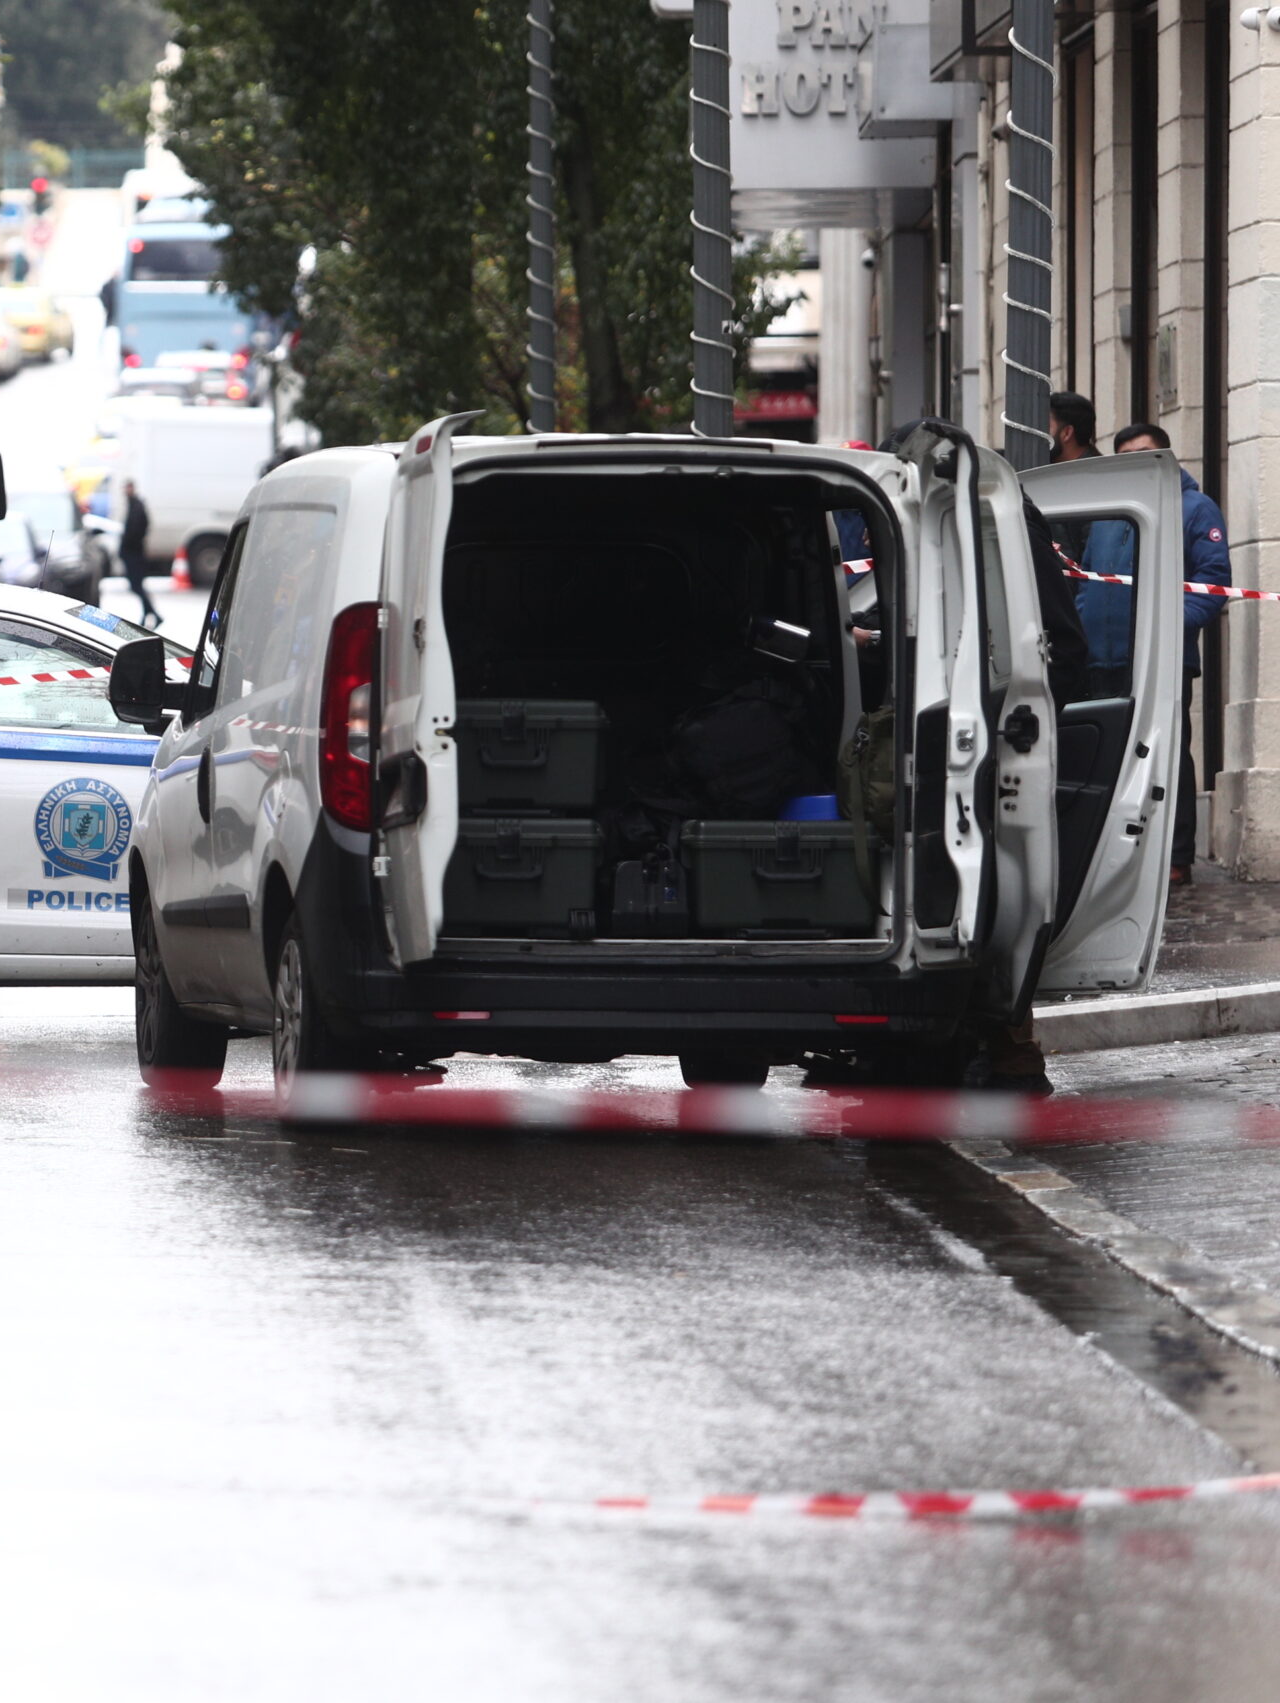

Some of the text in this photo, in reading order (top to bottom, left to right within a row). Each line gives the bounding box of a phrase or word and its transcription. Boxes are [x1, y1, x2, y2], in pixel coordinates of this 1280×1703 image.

[38, 780, 130, 856] ΕΛΛΗΝΙΚΗ ΑΣΤΥΝΟΜΙΑ
[27, 889, 130, 912] POLICE
